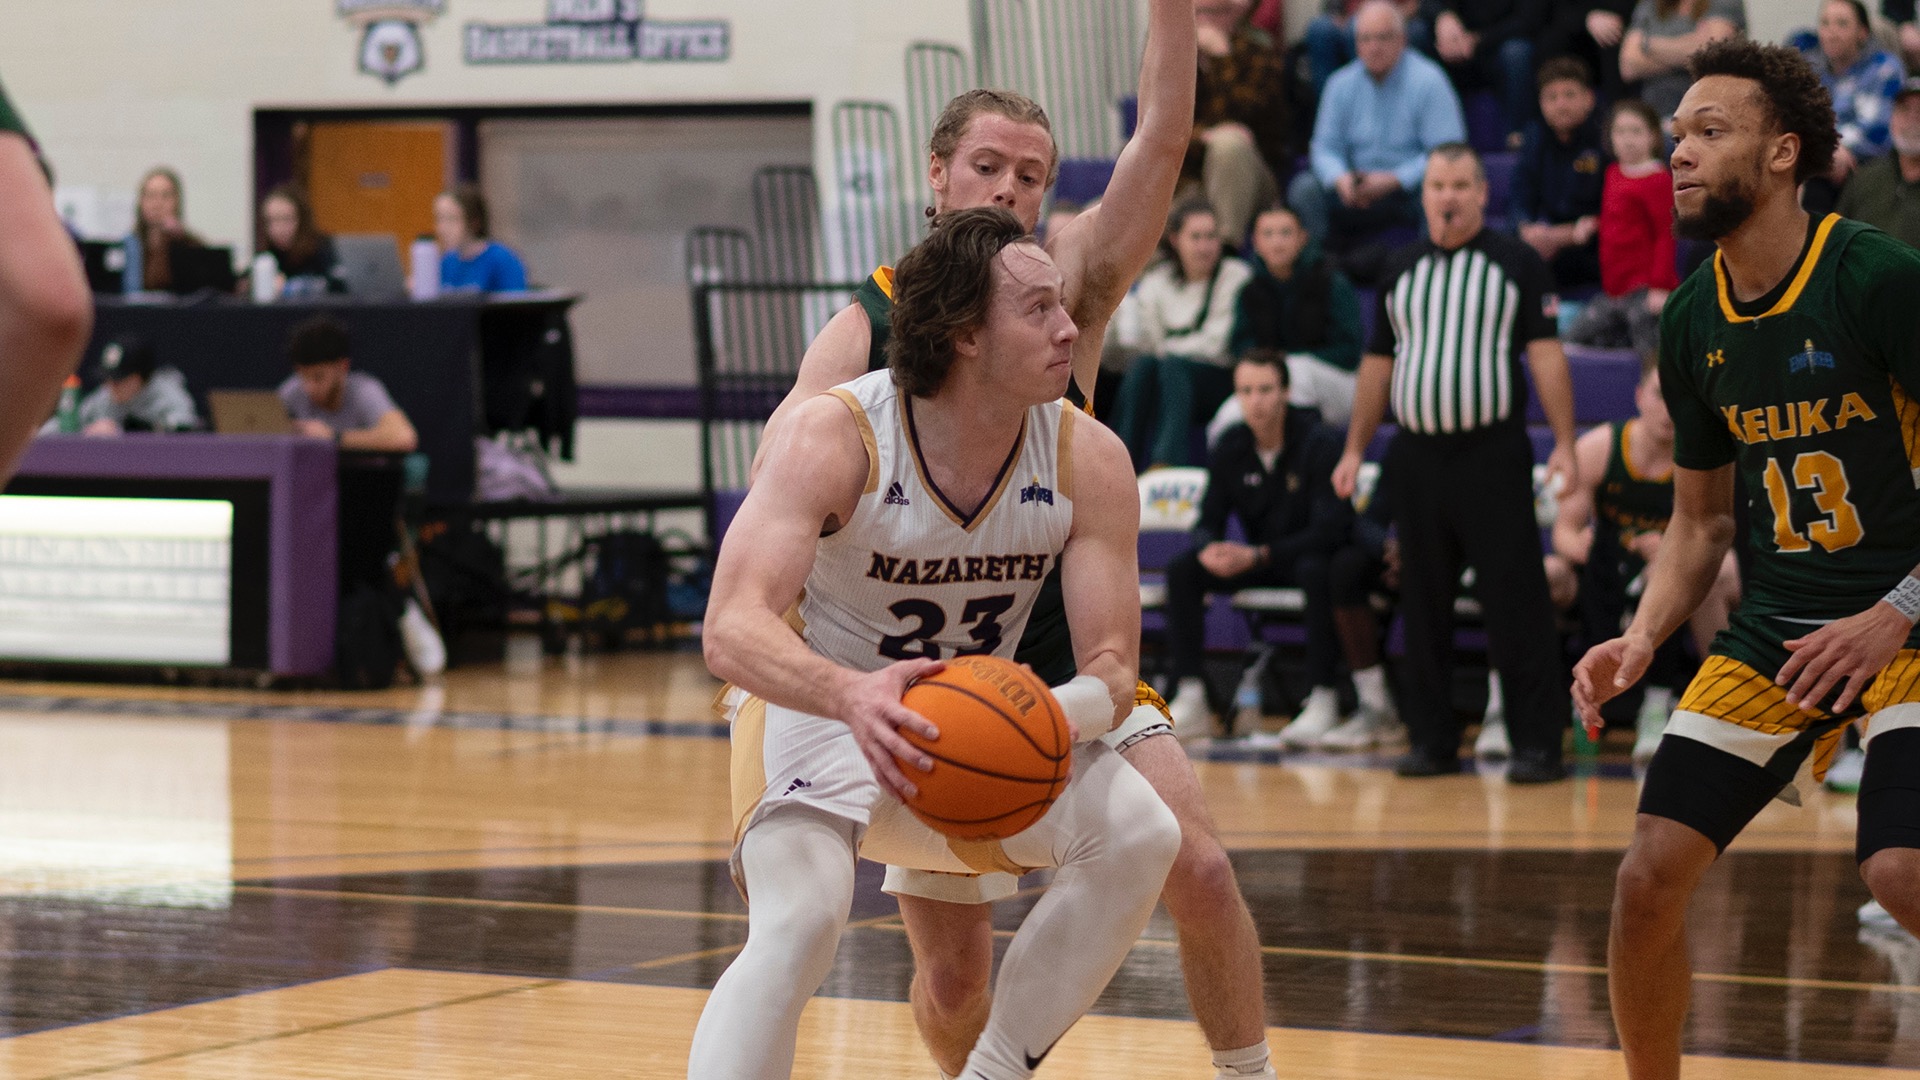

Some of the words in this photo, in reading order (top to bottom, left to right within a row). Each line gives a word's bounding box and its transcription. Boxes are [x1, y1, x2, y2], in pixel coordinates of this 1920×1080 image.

[1720, 392, 1877, 444] KEUKA
[884, 495, 910, 505] adidas
[1763, 450, 1865, 553] 13
[866, 551, 1049, 585] NAZARETH
[878, 592, 1016, 662] 23
